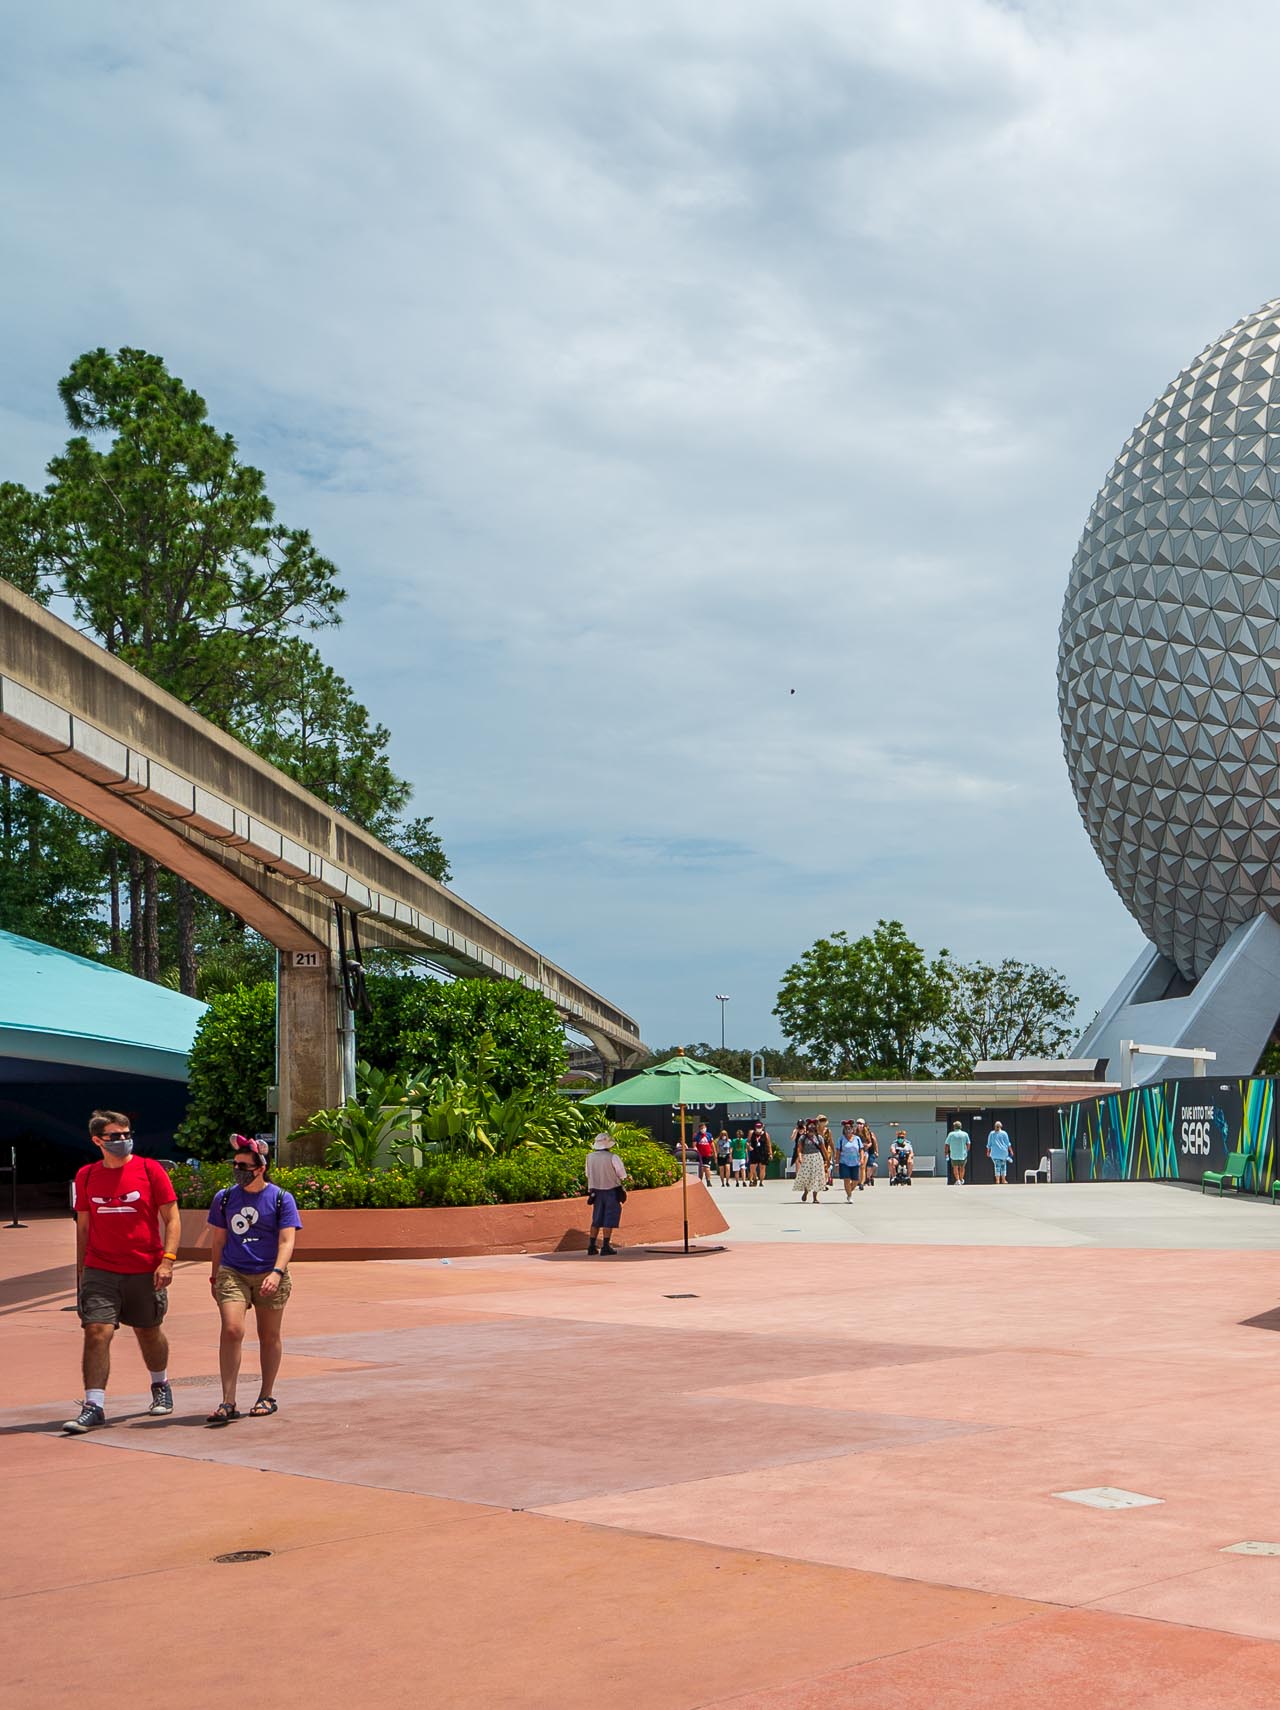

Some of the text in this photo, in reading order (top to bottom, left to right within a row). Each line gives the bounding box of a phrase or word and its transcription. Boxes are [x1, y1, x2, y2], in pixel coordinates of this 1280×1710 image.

[296, 953, 317, 965] 211
[1181, 1105, 1214, 1120] DIVE INTO THE
[1181, 1121, 1211, 1156] SEAS
